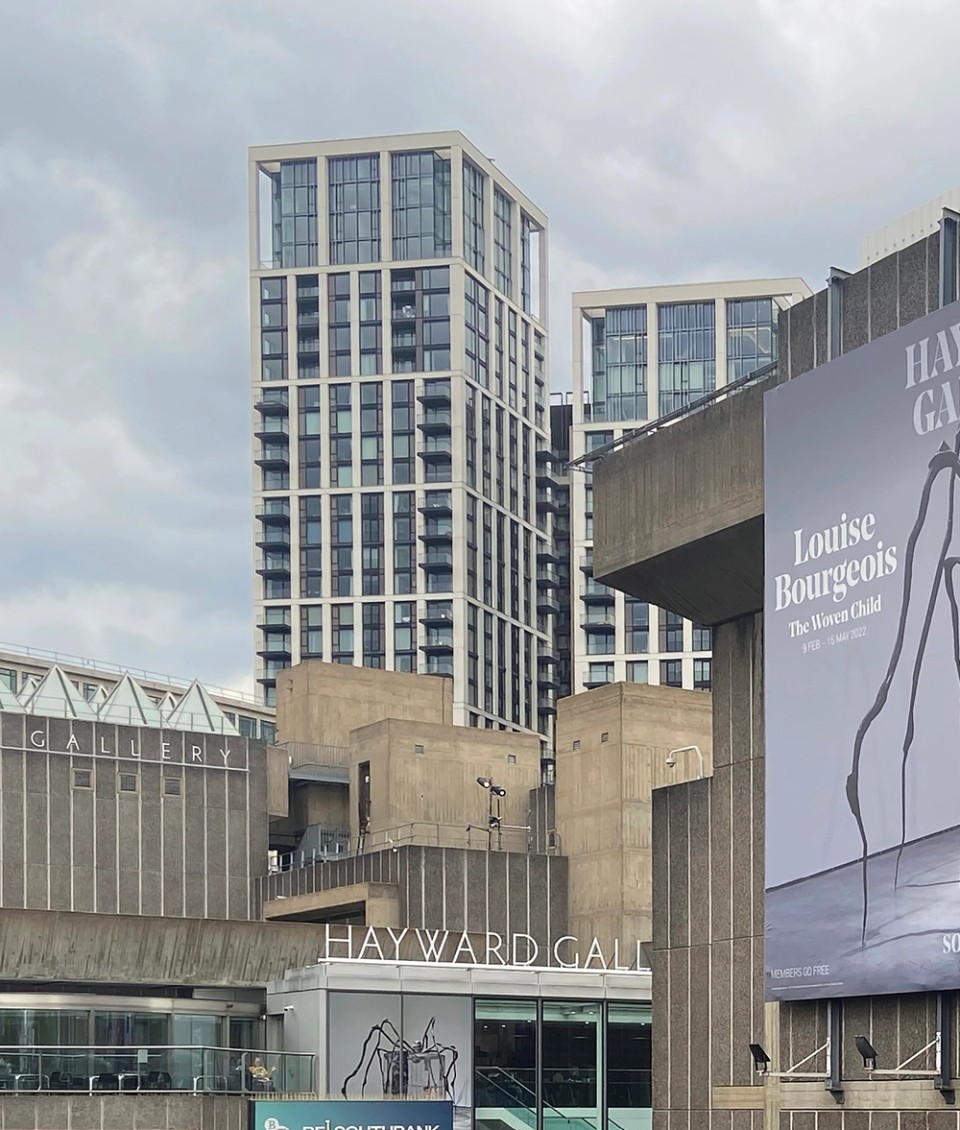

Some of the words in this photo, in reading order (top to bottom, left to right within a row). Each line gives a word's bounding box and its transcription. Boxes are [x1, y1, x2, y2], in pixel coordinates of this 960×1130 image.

[794, 512, 876, 566] Louise
[775, 541, 898, 611] Bourgeois
[789, 620, 810, 638] The
[811, 609, 849, 631] Woven
[851, 594, 882, 619] Child
[802, 643, 807, 653] 9
[808, 640, 821, 651] FEB
[827, 636, 835, 647] 15
[835, 633, 850, 645] MAY
[851, 626, 867, 640] 2022
[31, 730, 231, 765] GALLERY
[325, 924, 538, 966] HAYWARD
[770, 967, 802, 979] MEMBERS
[803, 966, 812, 976] GO
[813, 965, 830, 976] FREE
